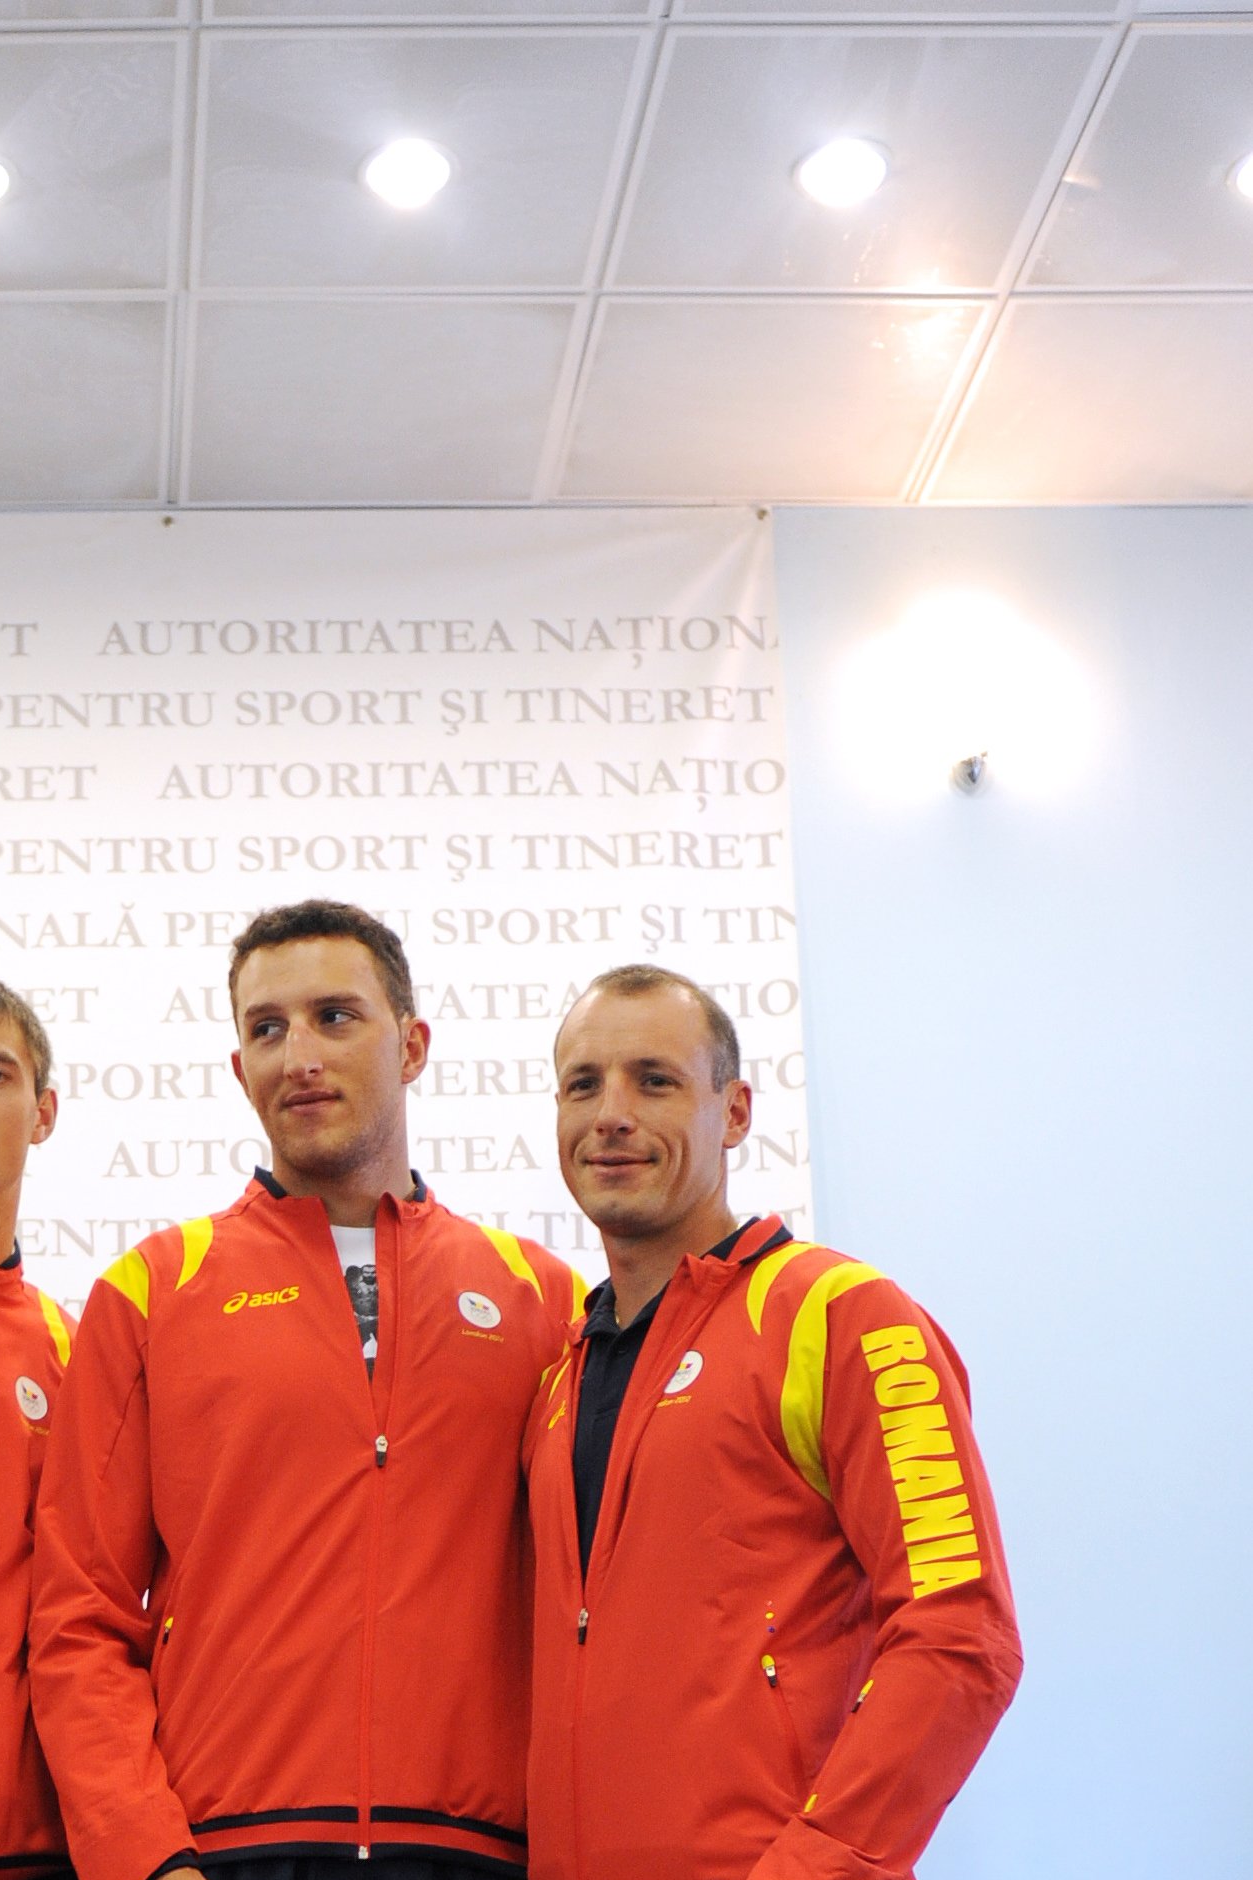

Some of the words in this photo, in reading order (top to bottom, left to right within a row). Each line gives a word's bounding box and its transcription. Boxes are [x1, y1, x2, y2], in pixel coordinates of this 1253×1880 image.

[96, 616, 518, 658] AUTORITATEA
[531, 613, 780, 669] NAȚION
[235, 689, 423, 729] SPORT
[504, 685, 776, 726] TINERET
[157, 759, 583, 801] AUTORITATEA
[237, 833, 428, 873] SPORT
[510, 830, 784, 871] TINERET
[431, 906, 621, 946] SPORT
[247, 1285, 301, 1309] asics
[859, 1324, 983, 1600] ROMANIA
